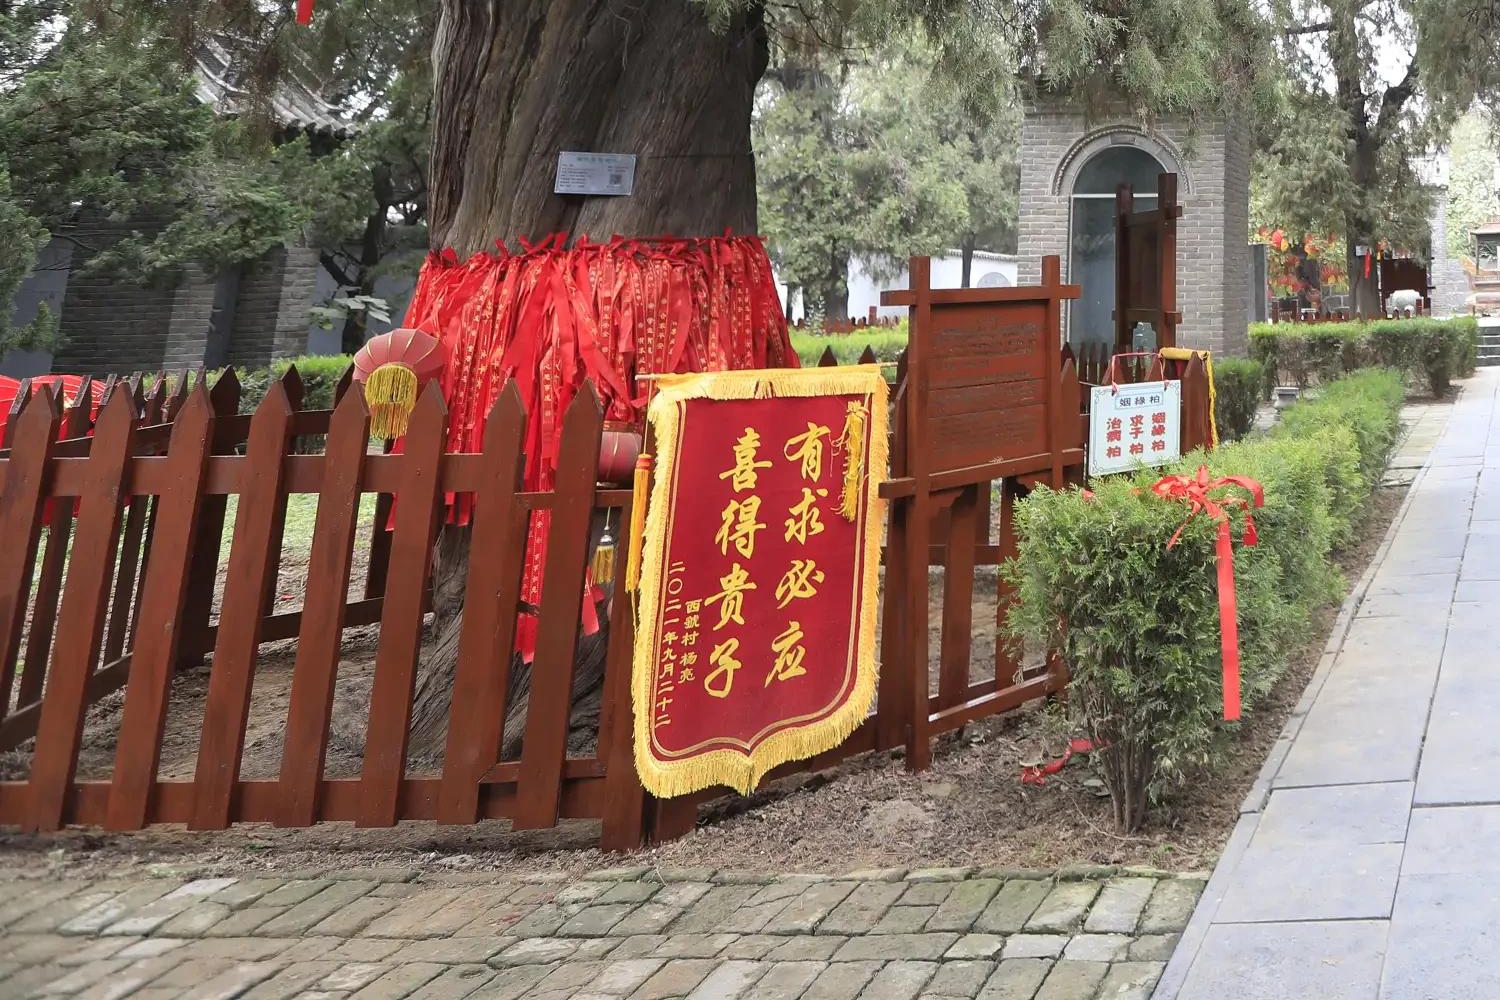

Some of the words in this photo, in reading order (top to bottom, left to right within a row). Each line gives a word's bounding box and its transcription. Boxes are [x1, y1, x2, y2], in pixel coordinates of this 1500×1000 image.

[703, 426, 773, 699] 喜得贵子
[764, 421, 832, 688] 有求必应
